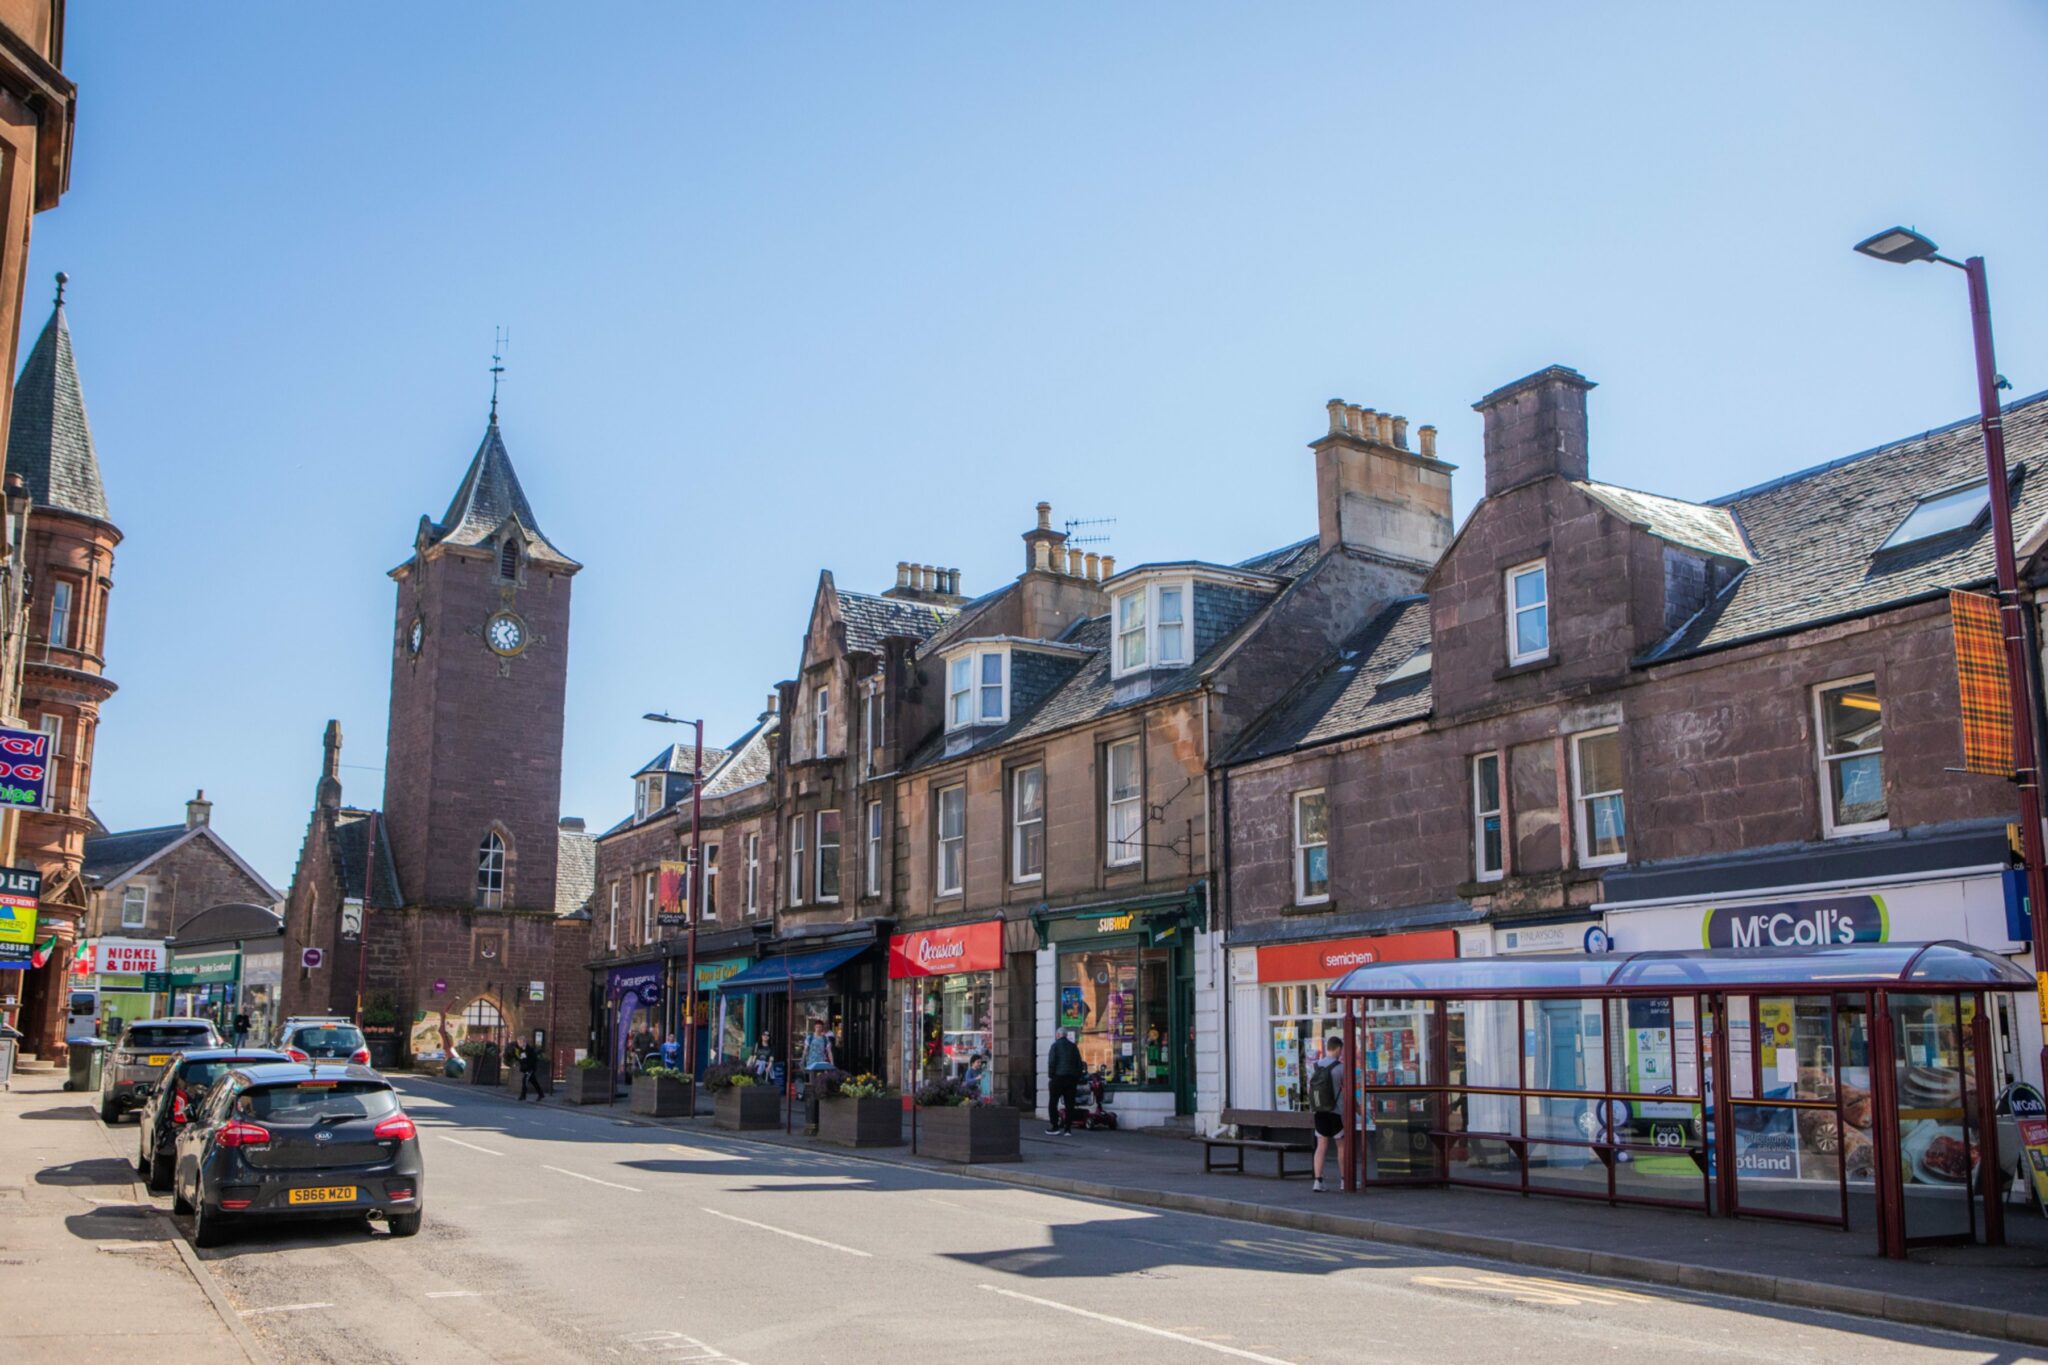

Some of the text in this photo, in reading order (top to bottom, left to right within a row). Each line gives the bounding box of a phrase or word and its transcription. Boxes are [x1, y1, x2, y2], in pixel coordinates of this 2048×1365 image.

[8, 873, 40, 891] LET
[1097, 912, 1135, 933] SUBWAY
[1731, 909, 1855, 948] McColl's
[107, 947, 157, 960] NICKEL
[920, 937, 965, 962] Occasions
[106, 960, 157, 972] & DIME
[1326, 952, 1373, 967] semichem
[1656, 1133, 1680, 1148] go
[295, 1188, 352, 1201] SB66 MZO
